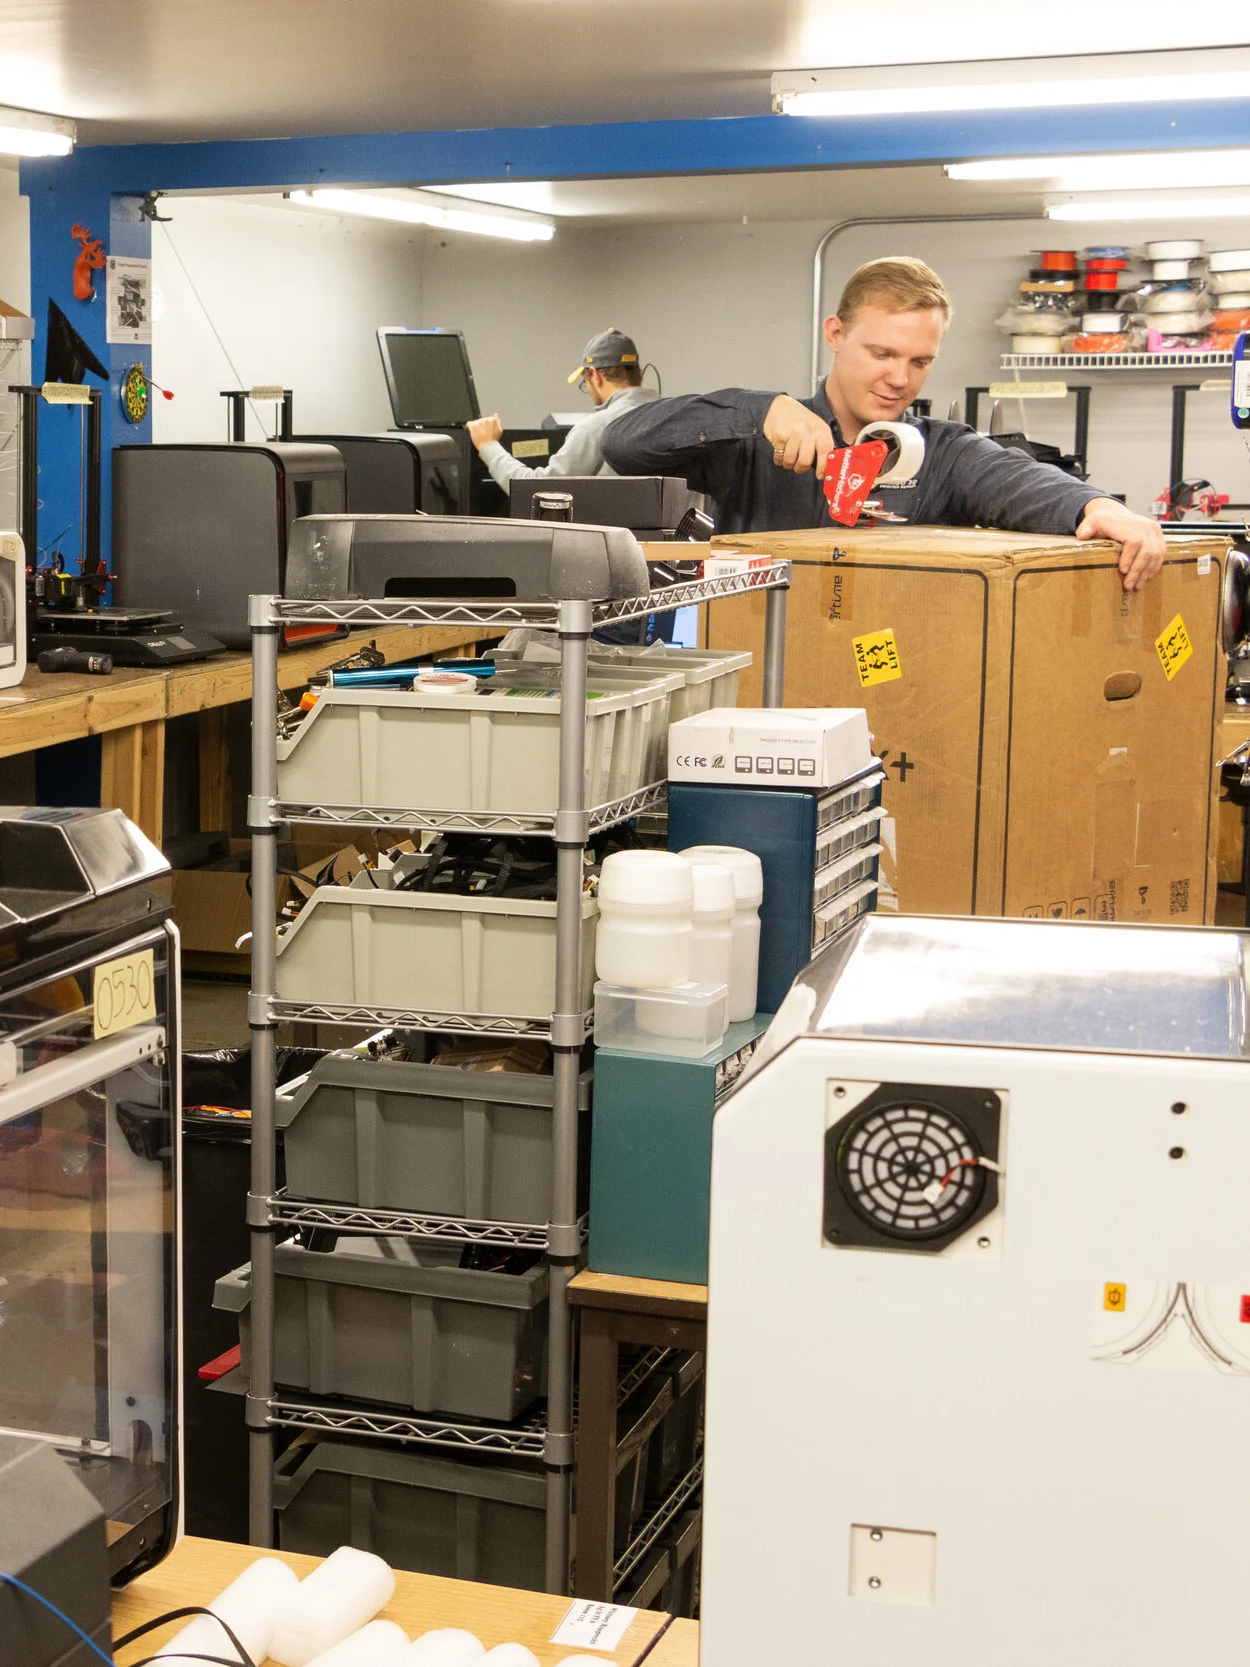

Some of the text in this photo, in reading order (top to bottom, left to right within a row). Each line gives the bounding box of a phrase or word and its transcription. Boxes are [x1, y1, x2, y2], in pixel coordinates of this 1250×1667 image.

[832, 449, 852, 508] MatterHackers
[1177, 625, 1189, 649] LIFT
[855, 643, 869, 682] TEAM
[885, 640, 898, 669] LIFT
[1158, 642, 1171, 676] TEAM
[676, 755, 691, 767] CE
[97, 960, 151, 1030] 0530
